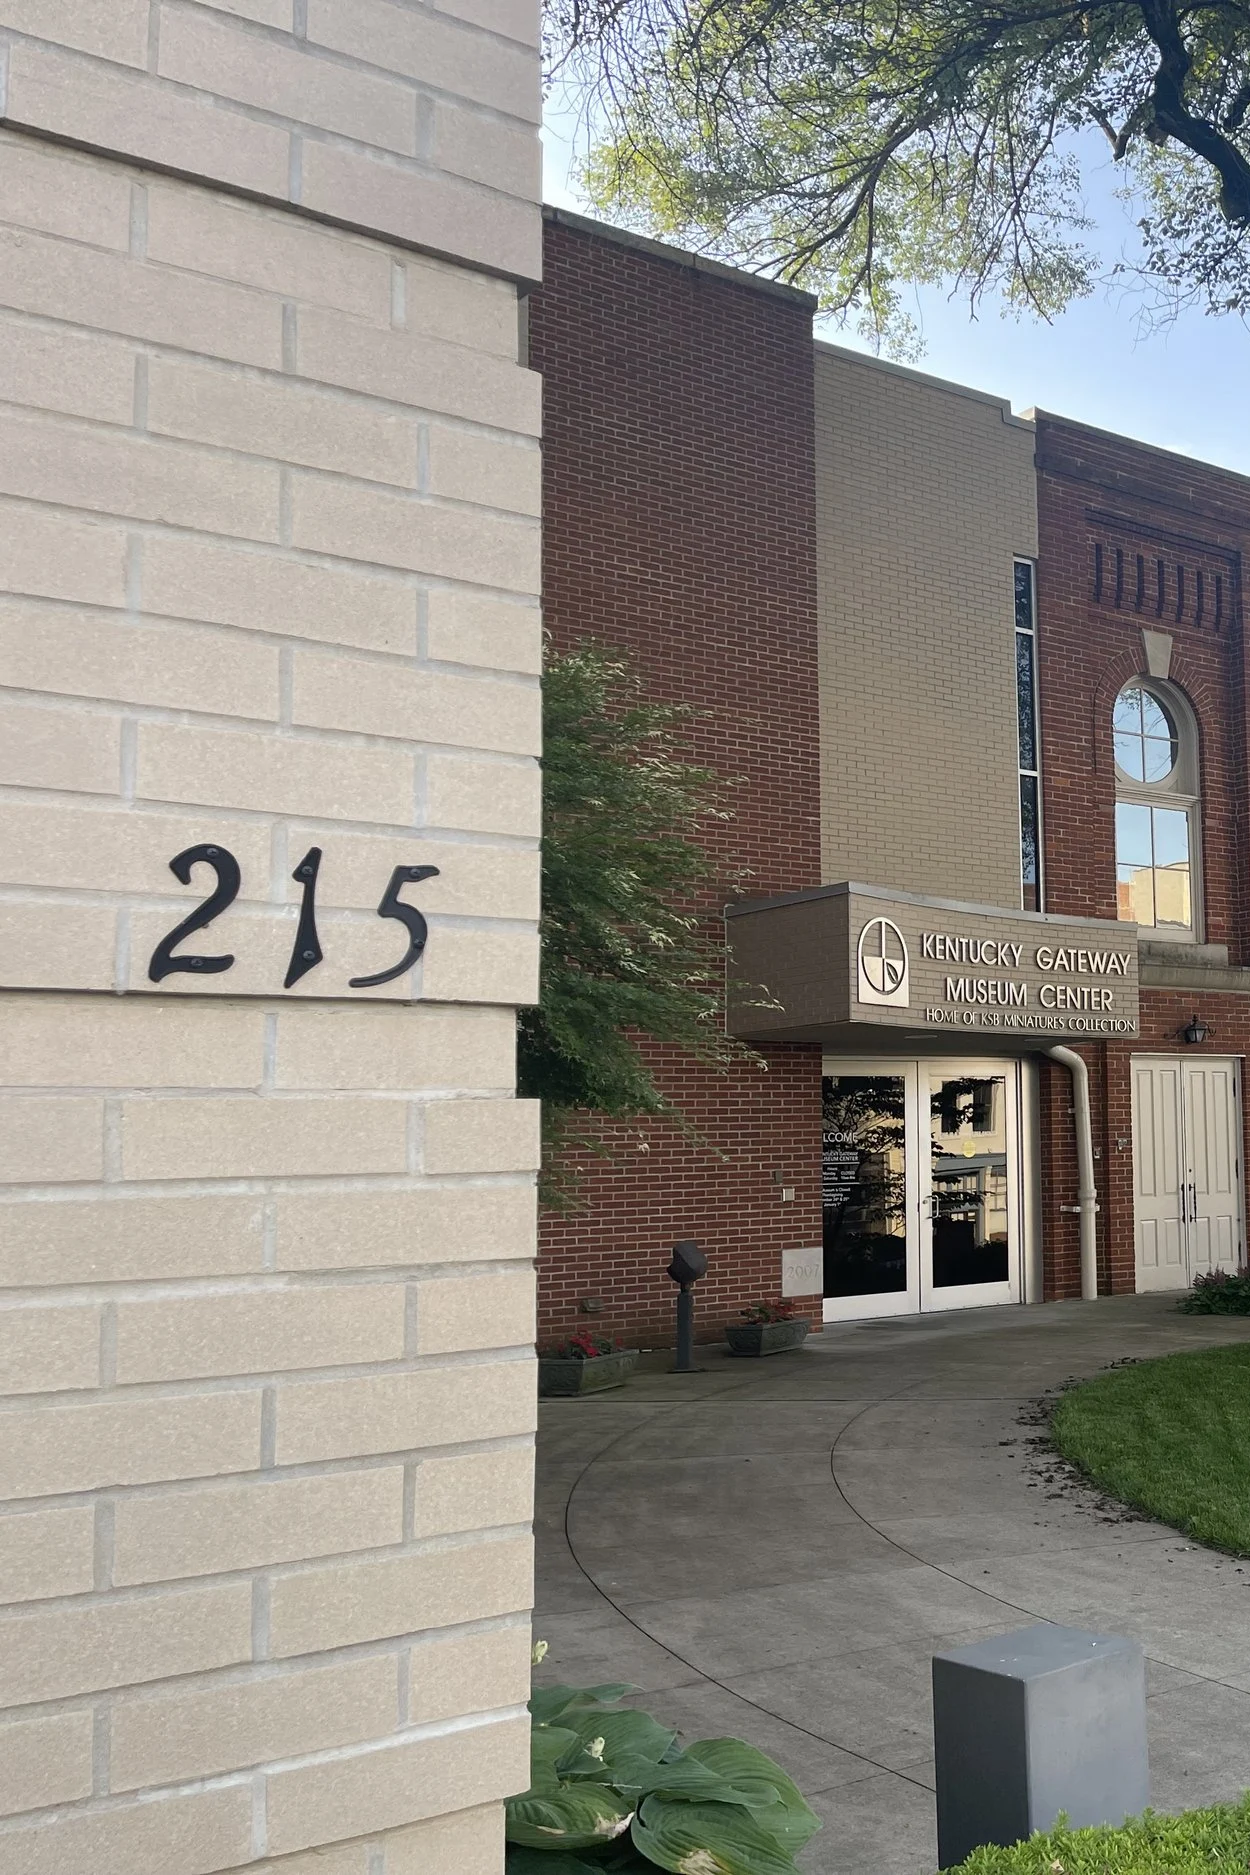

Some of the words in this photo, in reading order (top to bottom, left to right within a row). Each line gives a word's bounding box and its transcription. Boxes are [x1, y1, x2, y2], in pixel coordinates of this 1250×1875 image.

[149, 843, 440, 988] 215
[922, 932, 1023, 967] KENTUCKY
[1036, 946, 1131, 975] GATEWAY
[946, 976, 1027, 1007] MUSEUM
[1040, 984, 1113, 1011] CENTER
[926, 1007, 959, 1024] HOME
[963, 1010, 977, 1026] OF
[981, 1011, 1000, 1027] KSB
[1003, 1013, 1065, 1030] MINIATURES
[1068, 1017, 1136, 1033] COLLECTION
[787, 1263, 820, 1280] 2007
